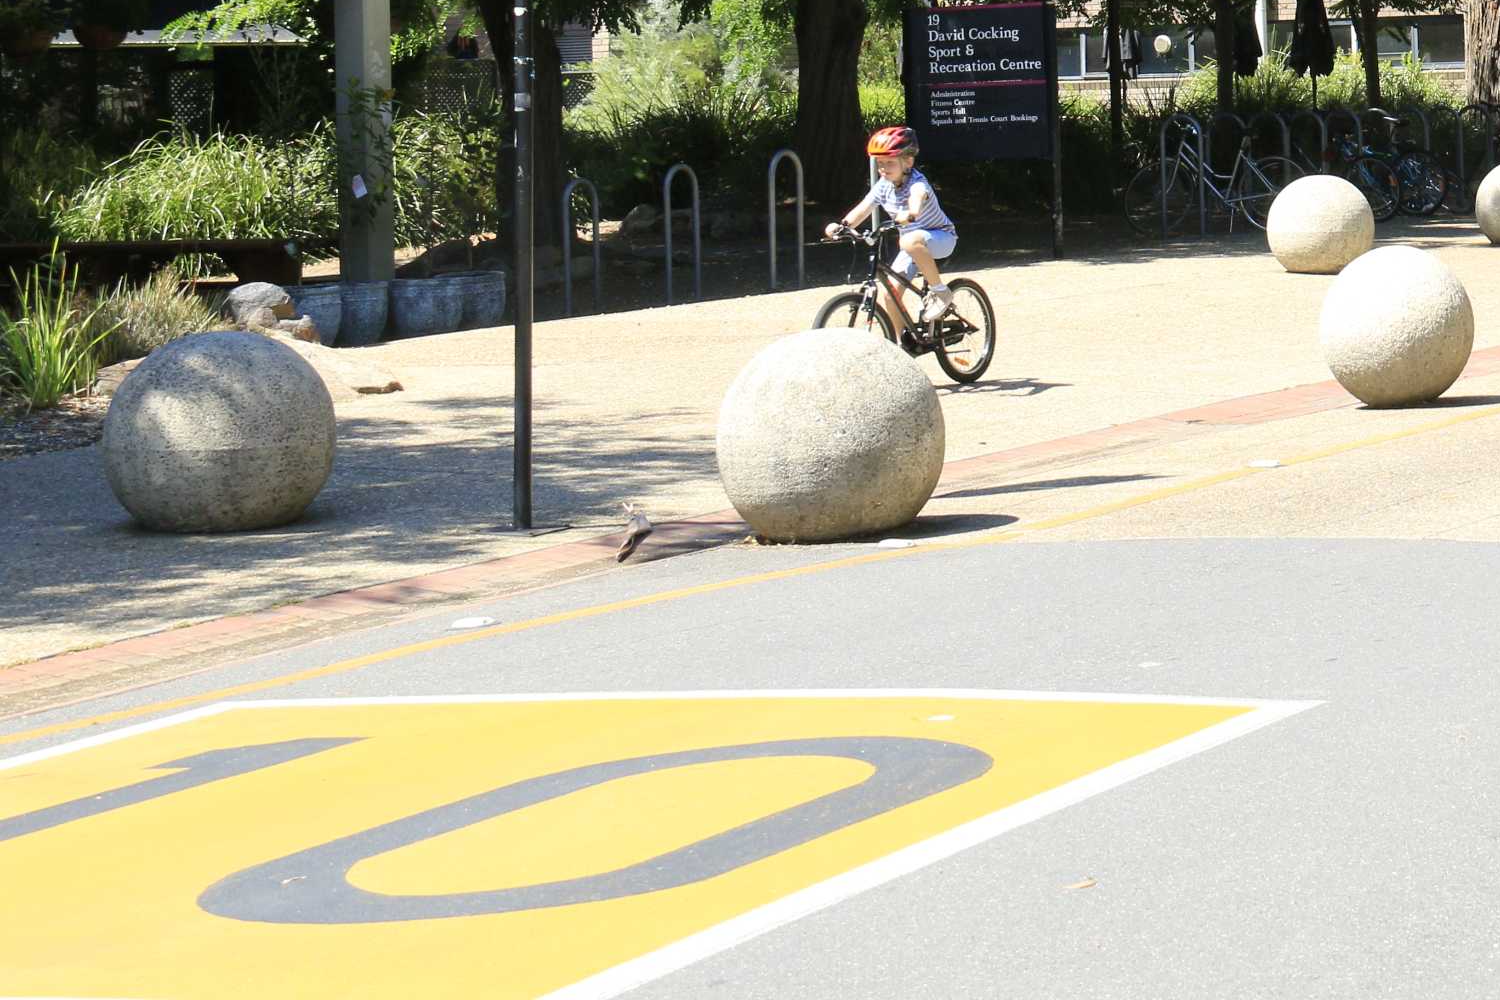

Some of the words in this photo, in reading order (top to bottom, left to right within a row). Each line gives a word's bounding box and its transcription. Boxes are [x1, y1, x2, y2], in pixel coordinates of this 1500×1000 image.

[928, 14, 940, 26] 19
[928, 28, 965, 42] David
[968, 26, 1020, 42] Cocking
[928, 46, 960, 61] Sport
[965, 44, 975, 56] &
[930, 59, 996, 74] Recreation
[1000, 58, 1042, 71] Centre
[930, 90, 976, 98] Administration
[953, 98, 976, 106] Centre
[931, 109, 951, 118] Sports
[952, 107, 966, 115] Hall
[931, 117, 953, 127] Squash
[955, 116, 967, 124] and
[968, 116, 989, 124] Tennis
[1010, 114, 1039, 124] Bookings
